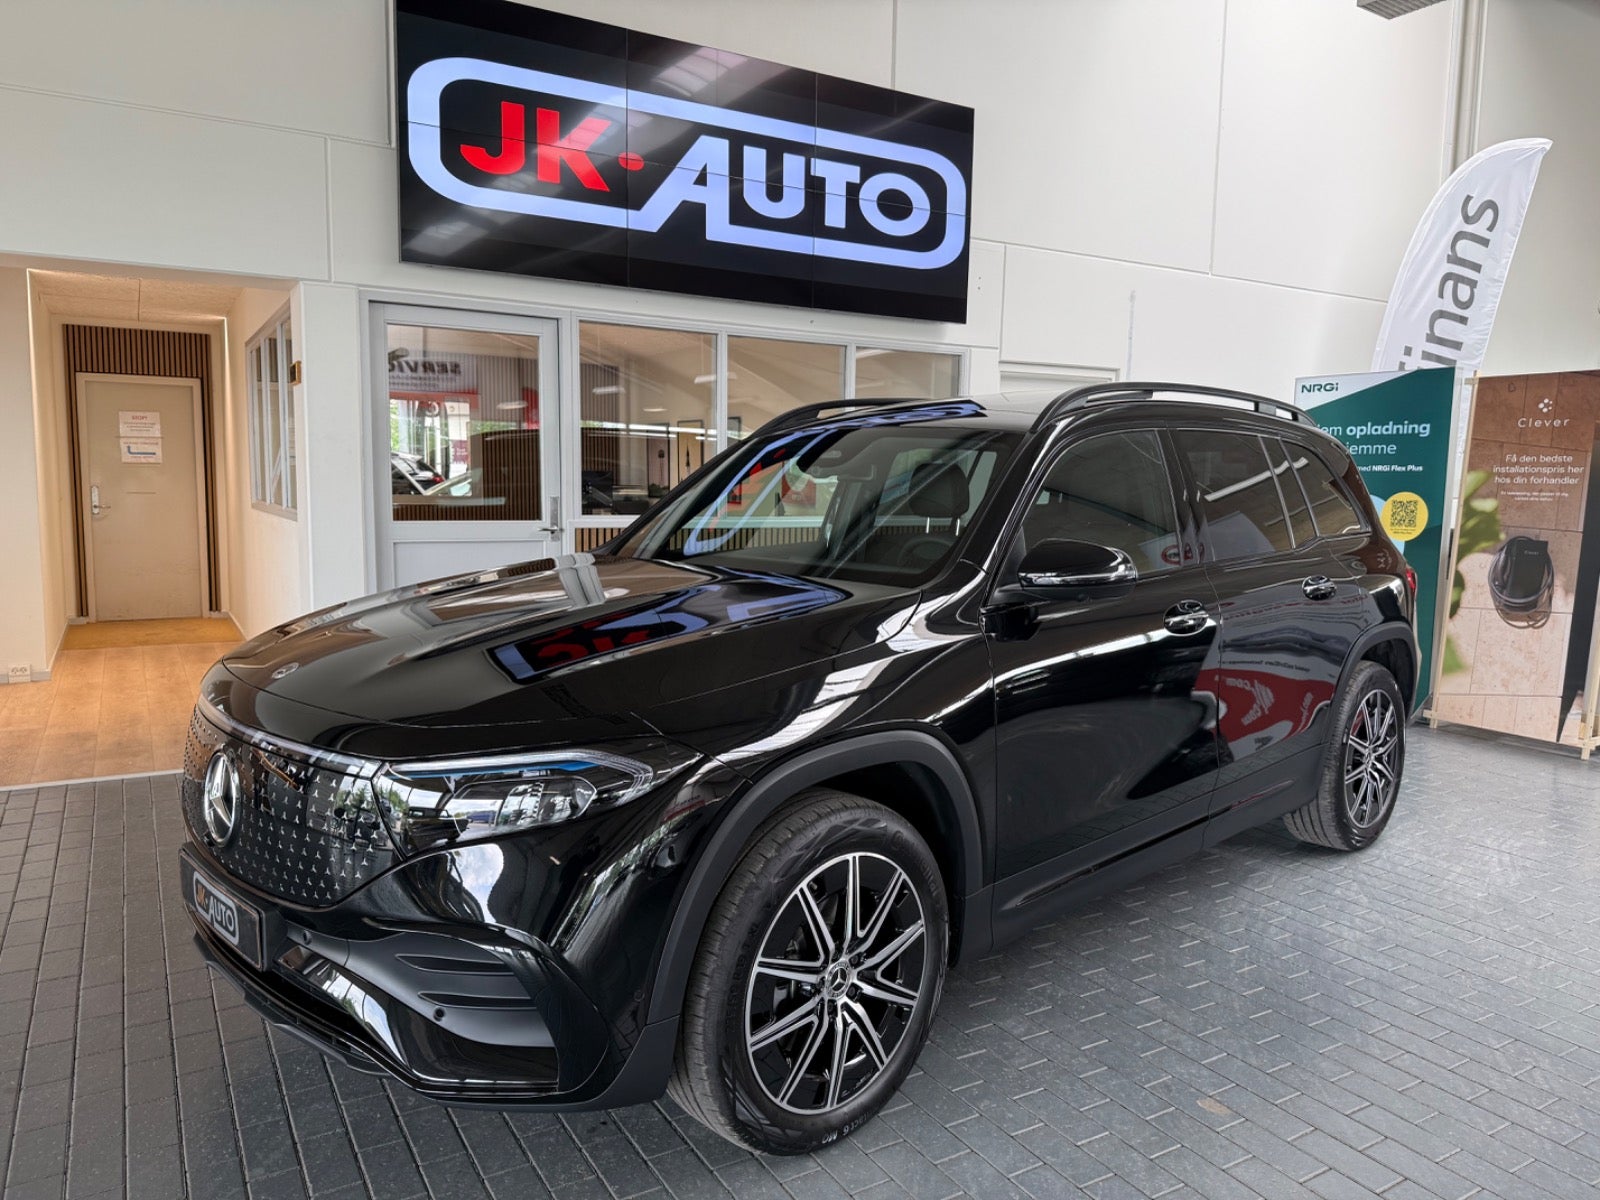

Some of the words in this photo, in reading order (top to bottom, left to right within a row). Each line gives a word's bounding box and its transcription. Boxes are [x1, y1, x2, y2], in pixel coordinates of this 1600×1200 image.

[1398, 194, 1499, 371] inans
[1301, 382, 1339, 393] NRGi
[1517, 417, 1570, 428] Clever
[1346, 421, 1431, 438] opladning
[1505, 453, 1517, 463] Få
[1519, 454, 1537, 463] den
[1539, 454, 1573, 463] bedste
[1493, 464, 1565, 475] installationspris
[1567, 464, 1585, 473] her
[1494, 475, 1511, 484] hos
[1513, 475, 1528, 484] din
[1530, 475, 1580, 485] forhandler
[208, 895, 235, 933] AUTO
